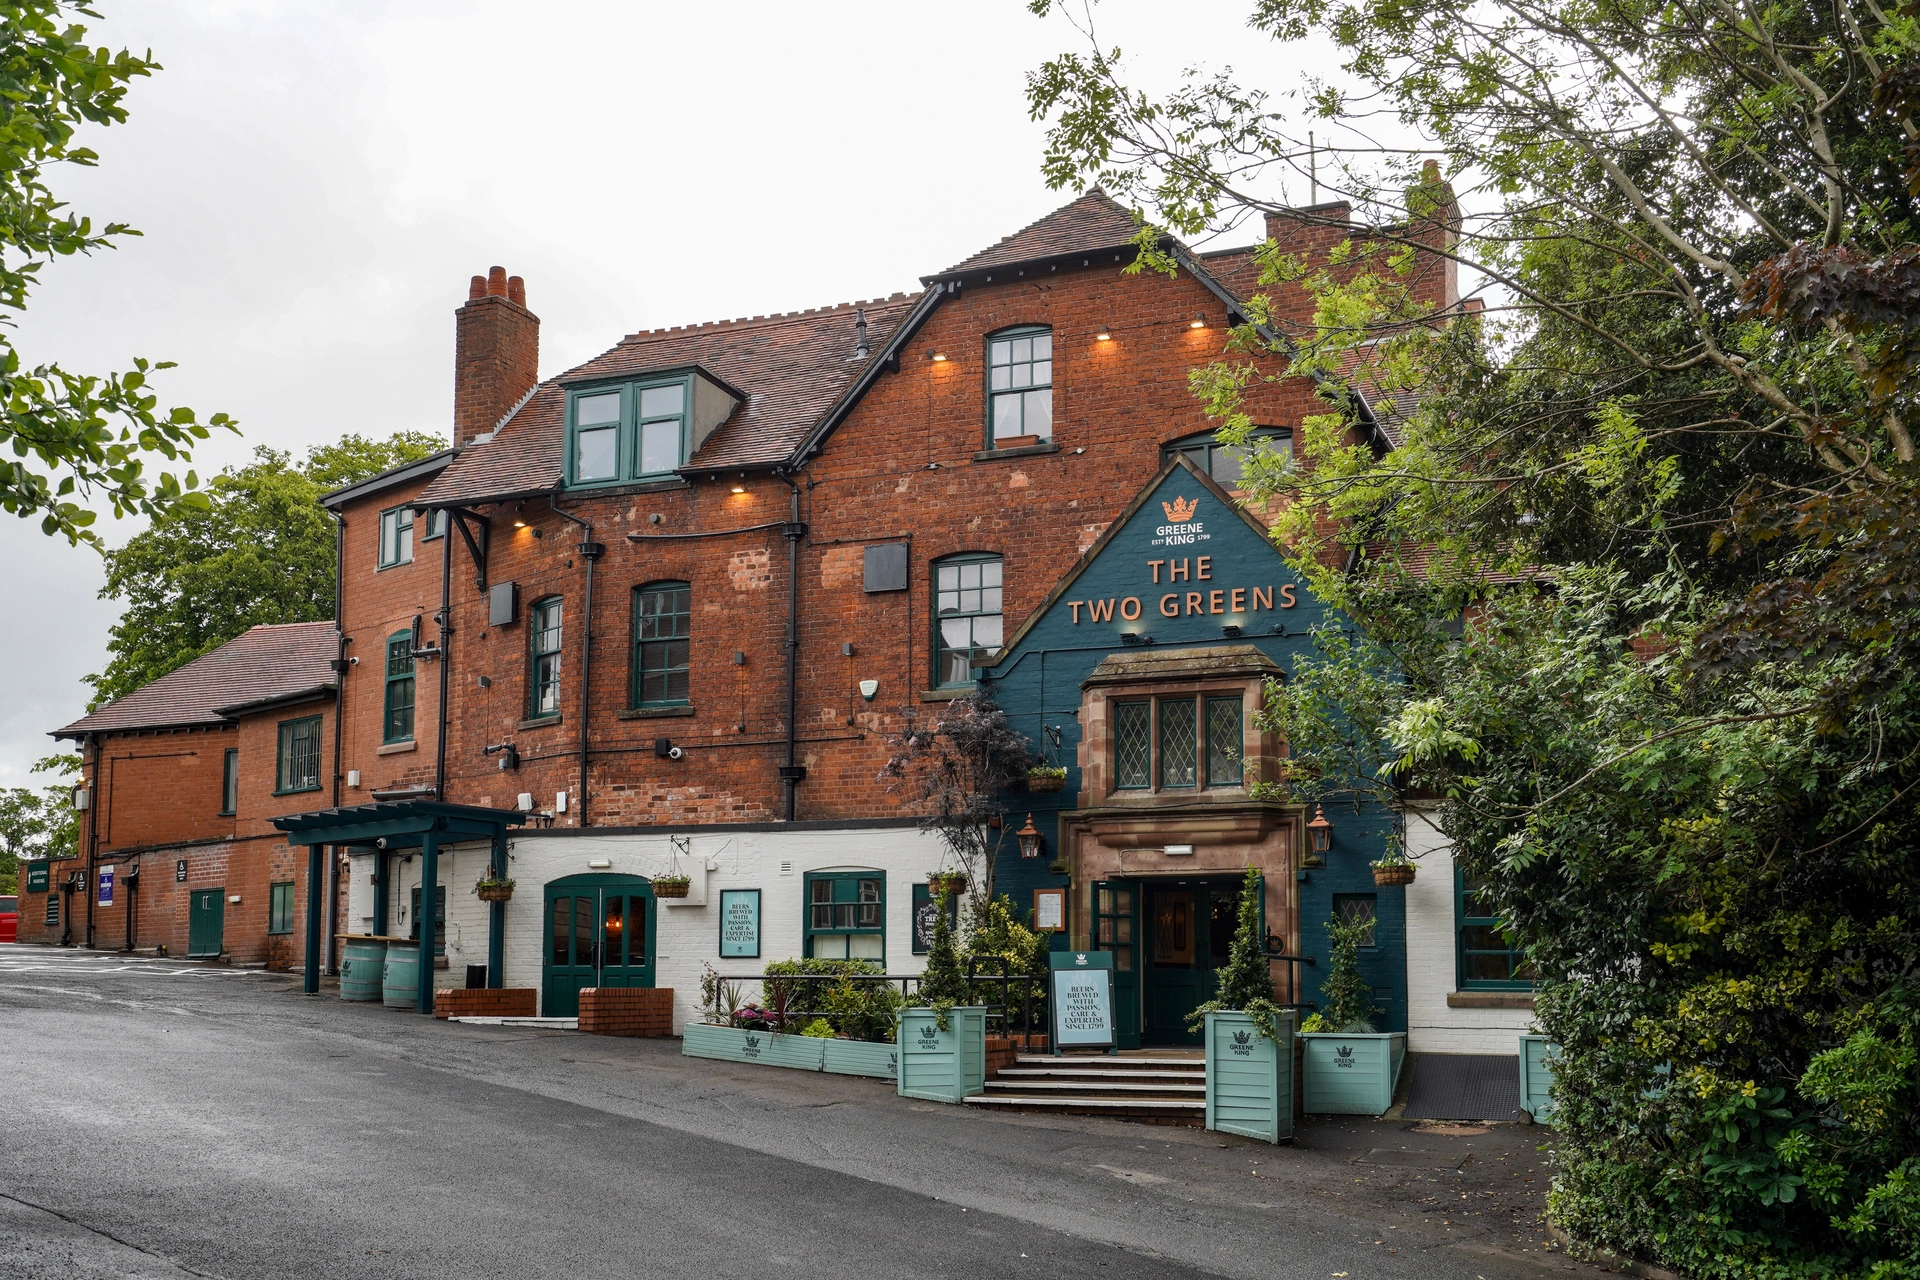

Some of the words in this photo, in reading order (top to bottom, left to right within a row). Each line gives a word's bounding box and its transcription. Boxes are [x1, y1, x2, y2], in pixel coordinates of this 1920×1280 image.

[1156, 522, 1203, 536] GREENE
[1165, 534, 1195, 546] KING
[1197, 533, 1211, 541] 1799
[1147, 556, 1212, 584] THE
[1067, 596, 1142, 624] TWO
[1159, 583, 1297, 618] GREENS
